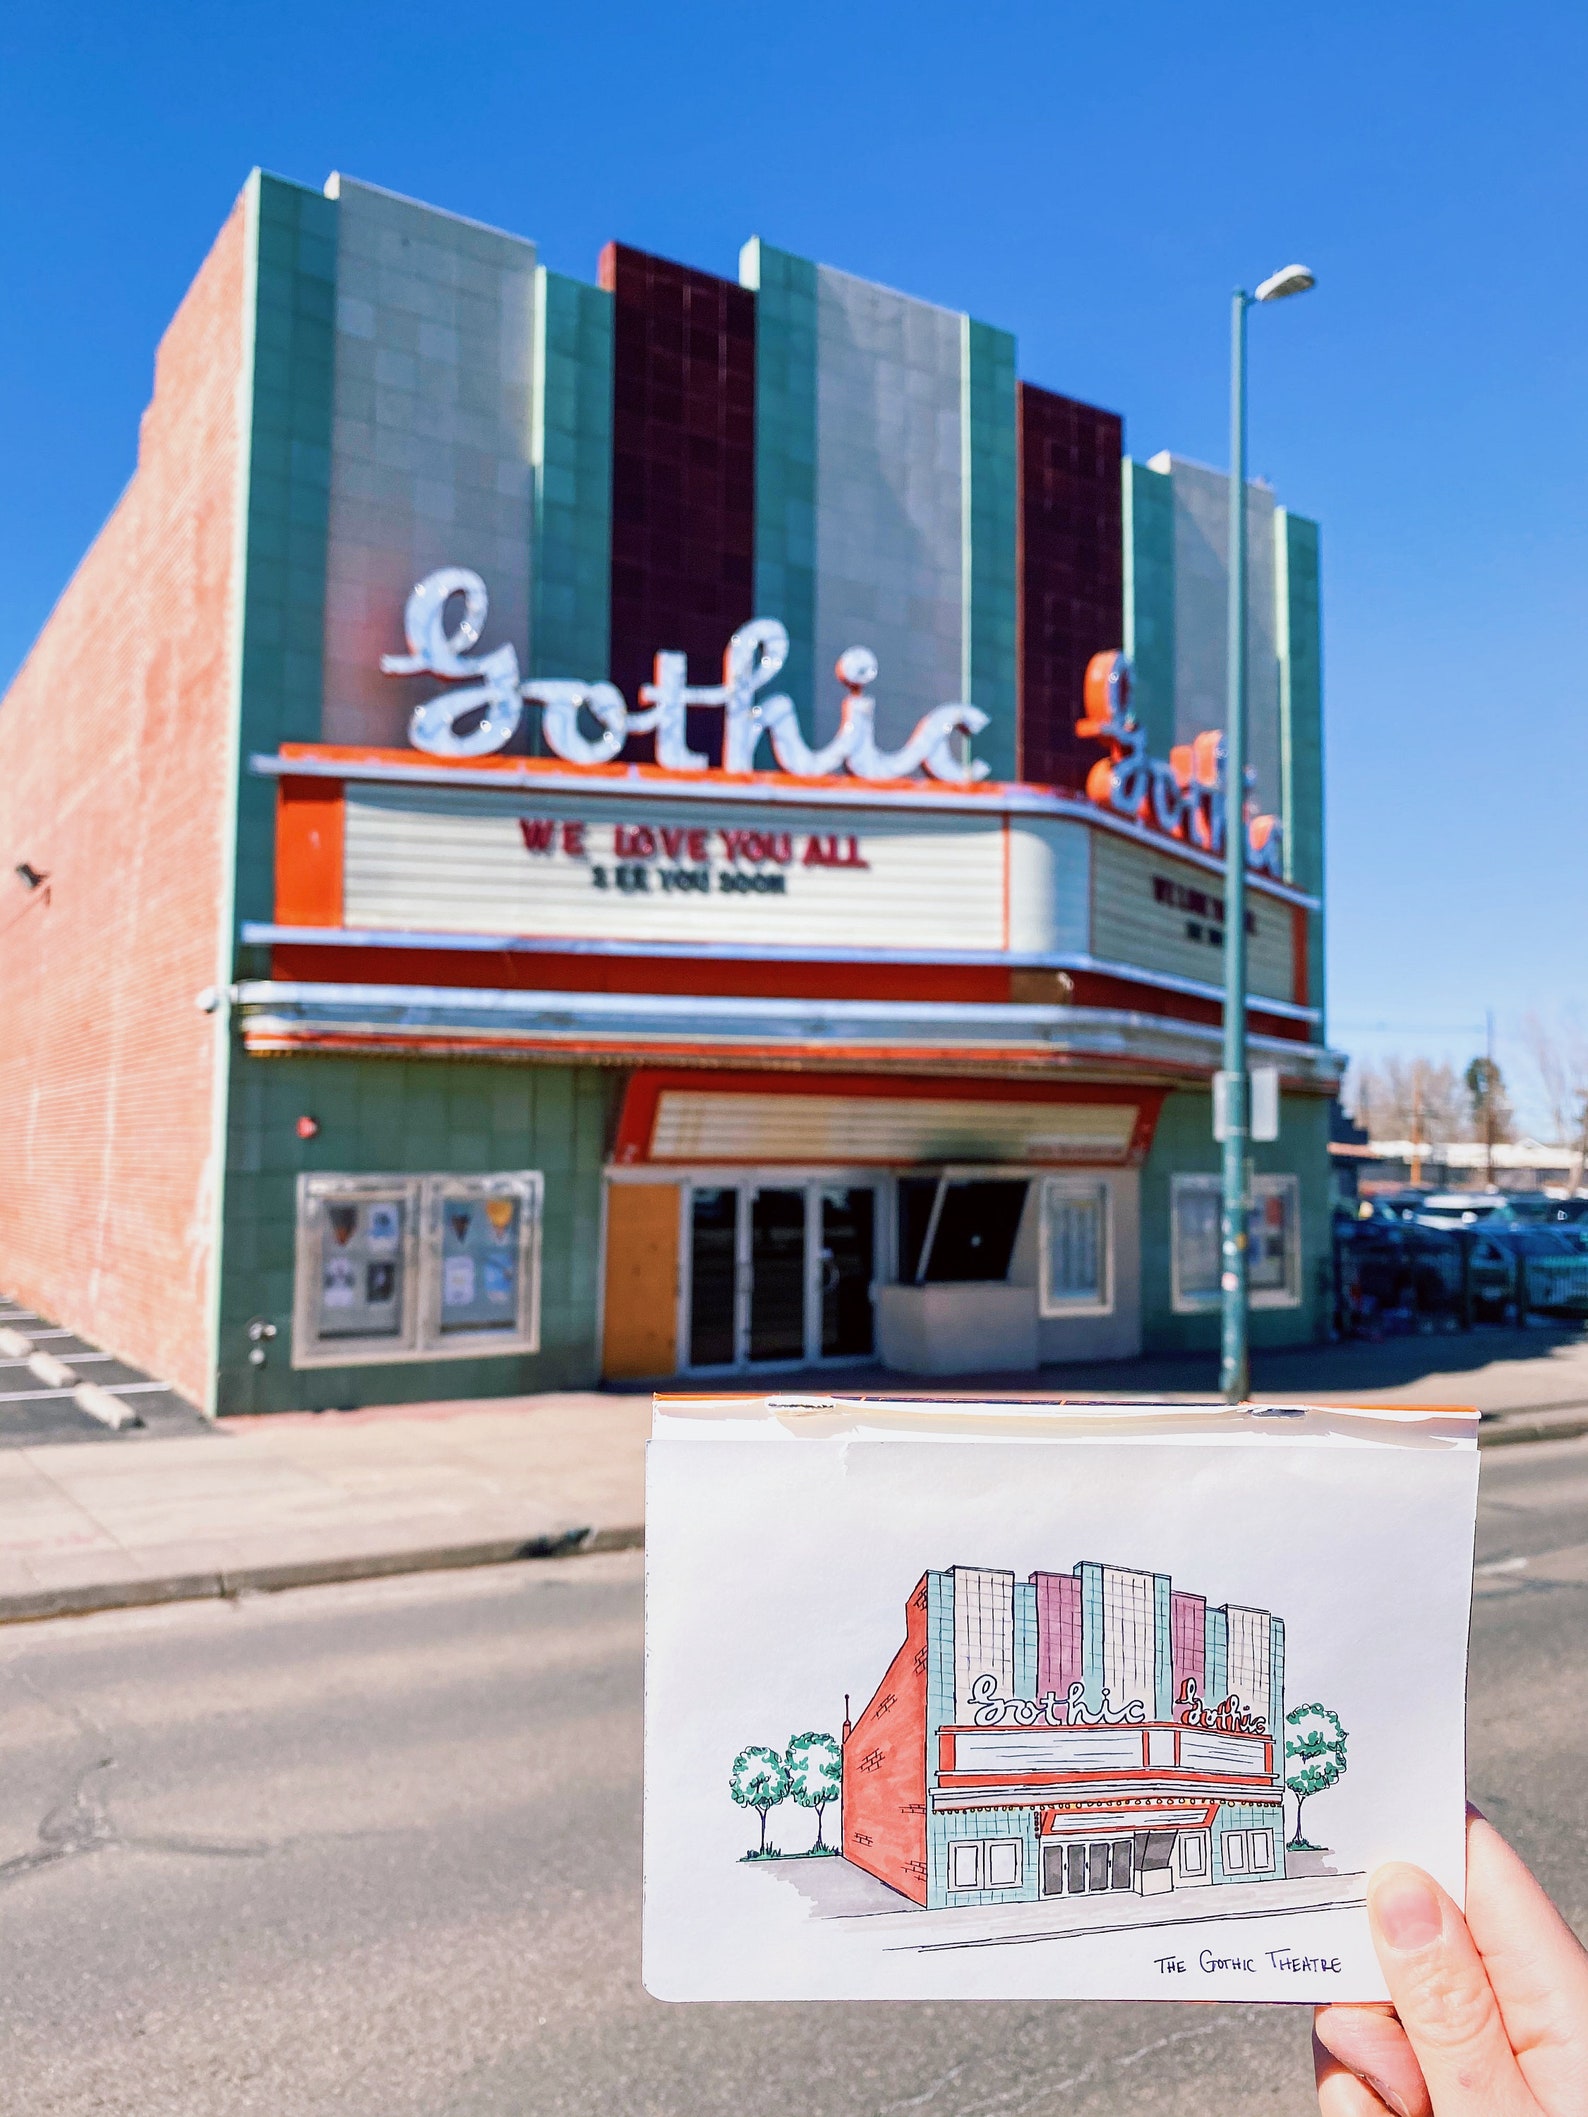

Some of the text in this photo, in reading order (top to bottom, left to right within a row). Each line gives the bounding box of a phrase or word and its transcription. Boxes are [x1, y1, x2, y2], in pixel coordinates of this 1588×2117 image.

[380, 566, 991, 783] Gothic
[518, 817, 870, 869] WE LOVE YOU ALL
[592, 864, 787, 895] SEE YOU SOON
[968, 1674, 1146, 1726] Gothic
[1175, 1677, 1267, 1735] Gothic
[1153, 1955, 1187, 1974] THE
[1264, 1948, 1342, 1973] THEATRE
